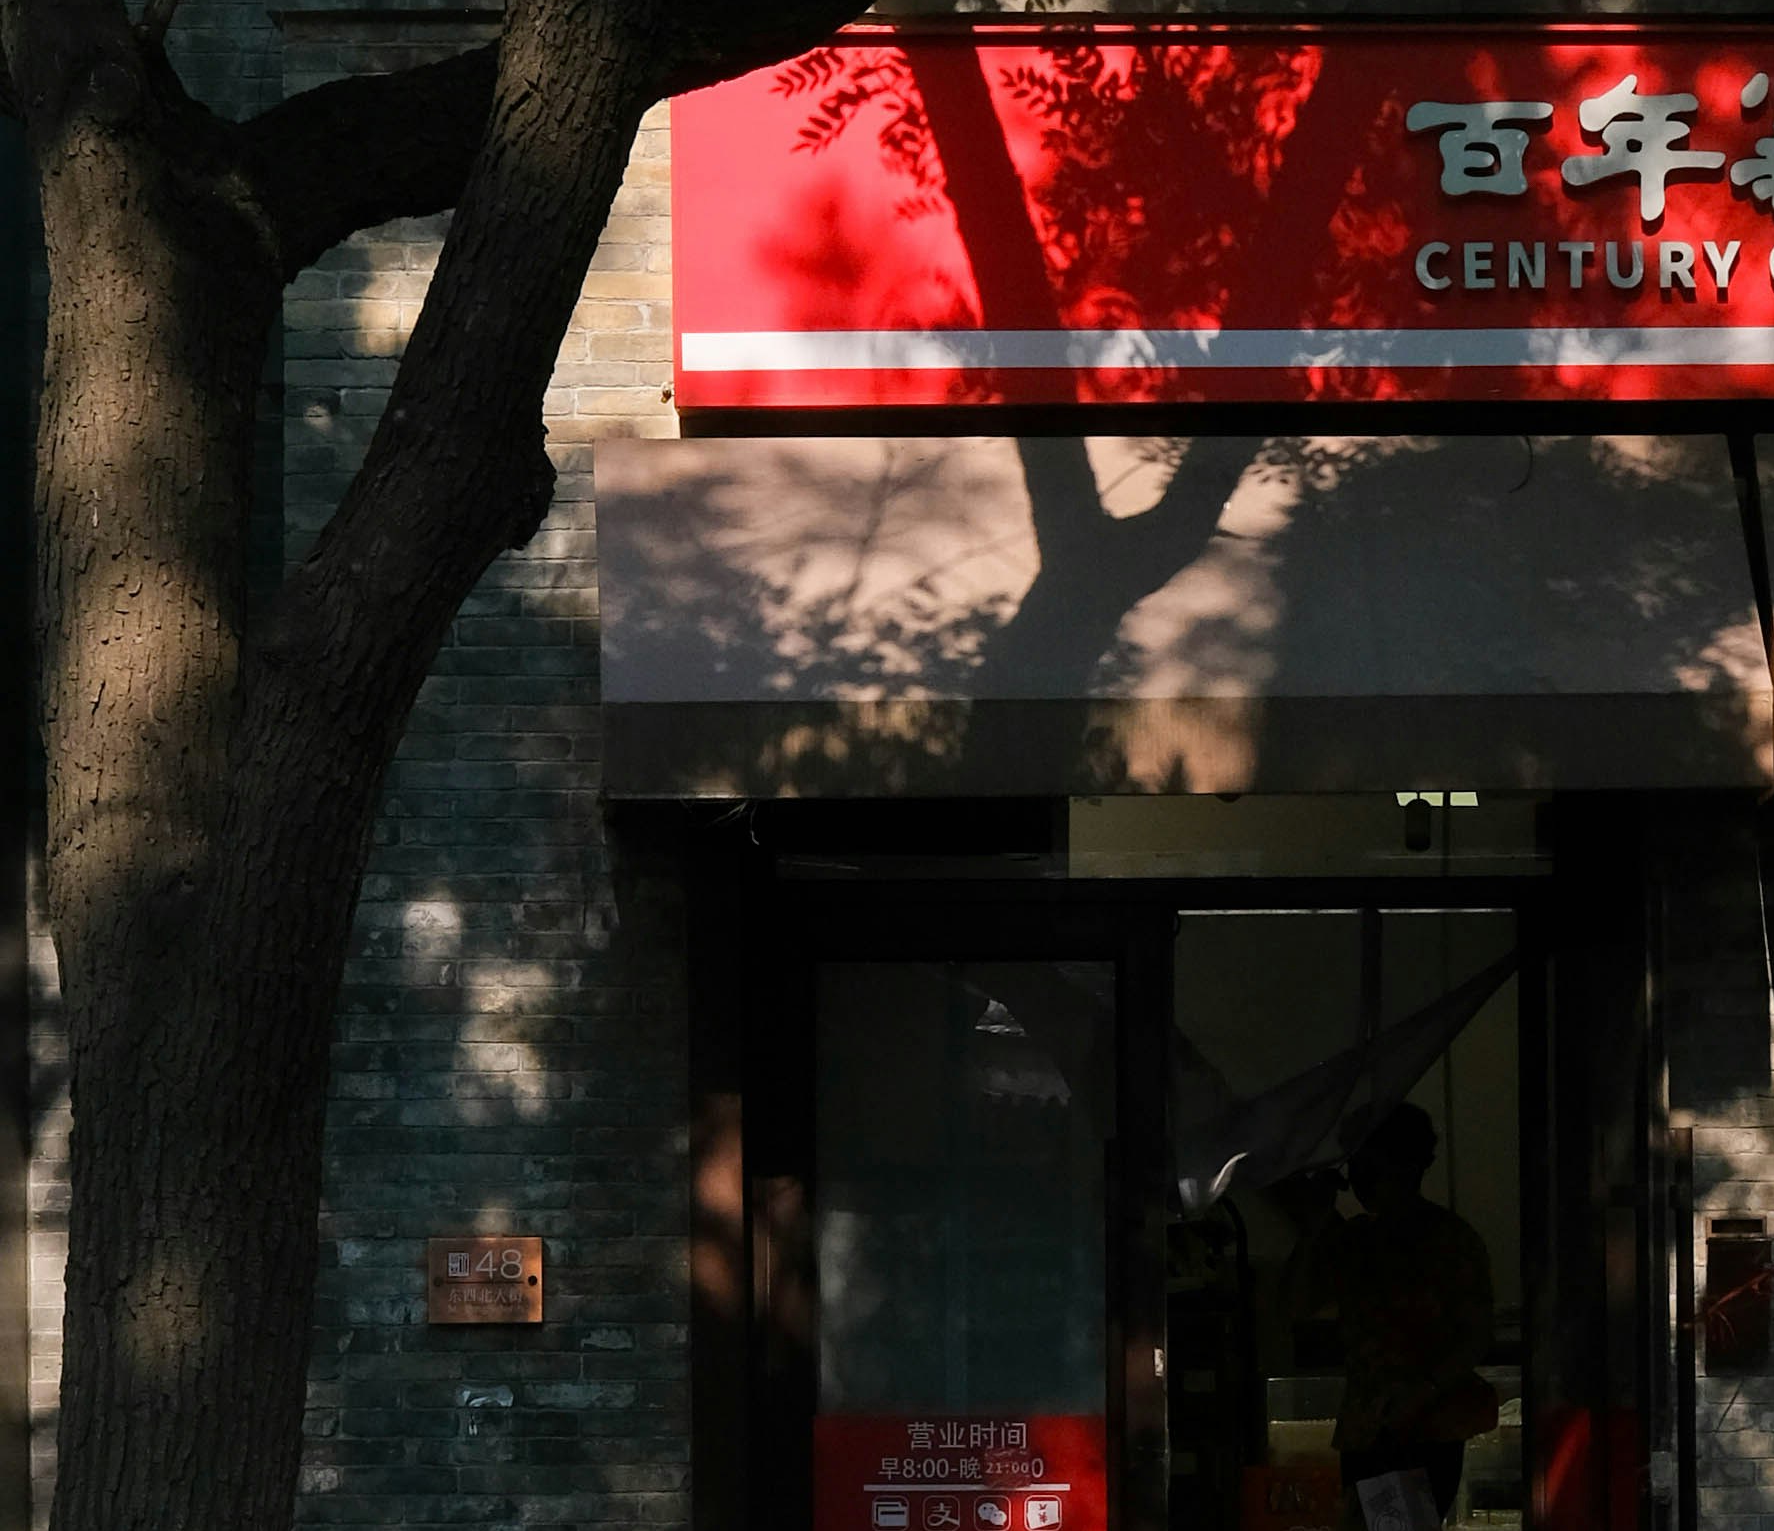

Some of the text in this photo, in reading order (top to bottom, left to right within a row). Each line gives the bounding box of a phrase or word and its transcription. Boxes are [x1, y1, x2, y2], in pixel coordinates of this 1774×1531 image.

[1415, 240, 1740, 290] CENTURY
[475, 1249, 522, 1280] 48
[907, 1422, 1028, 1450] 营业时间
